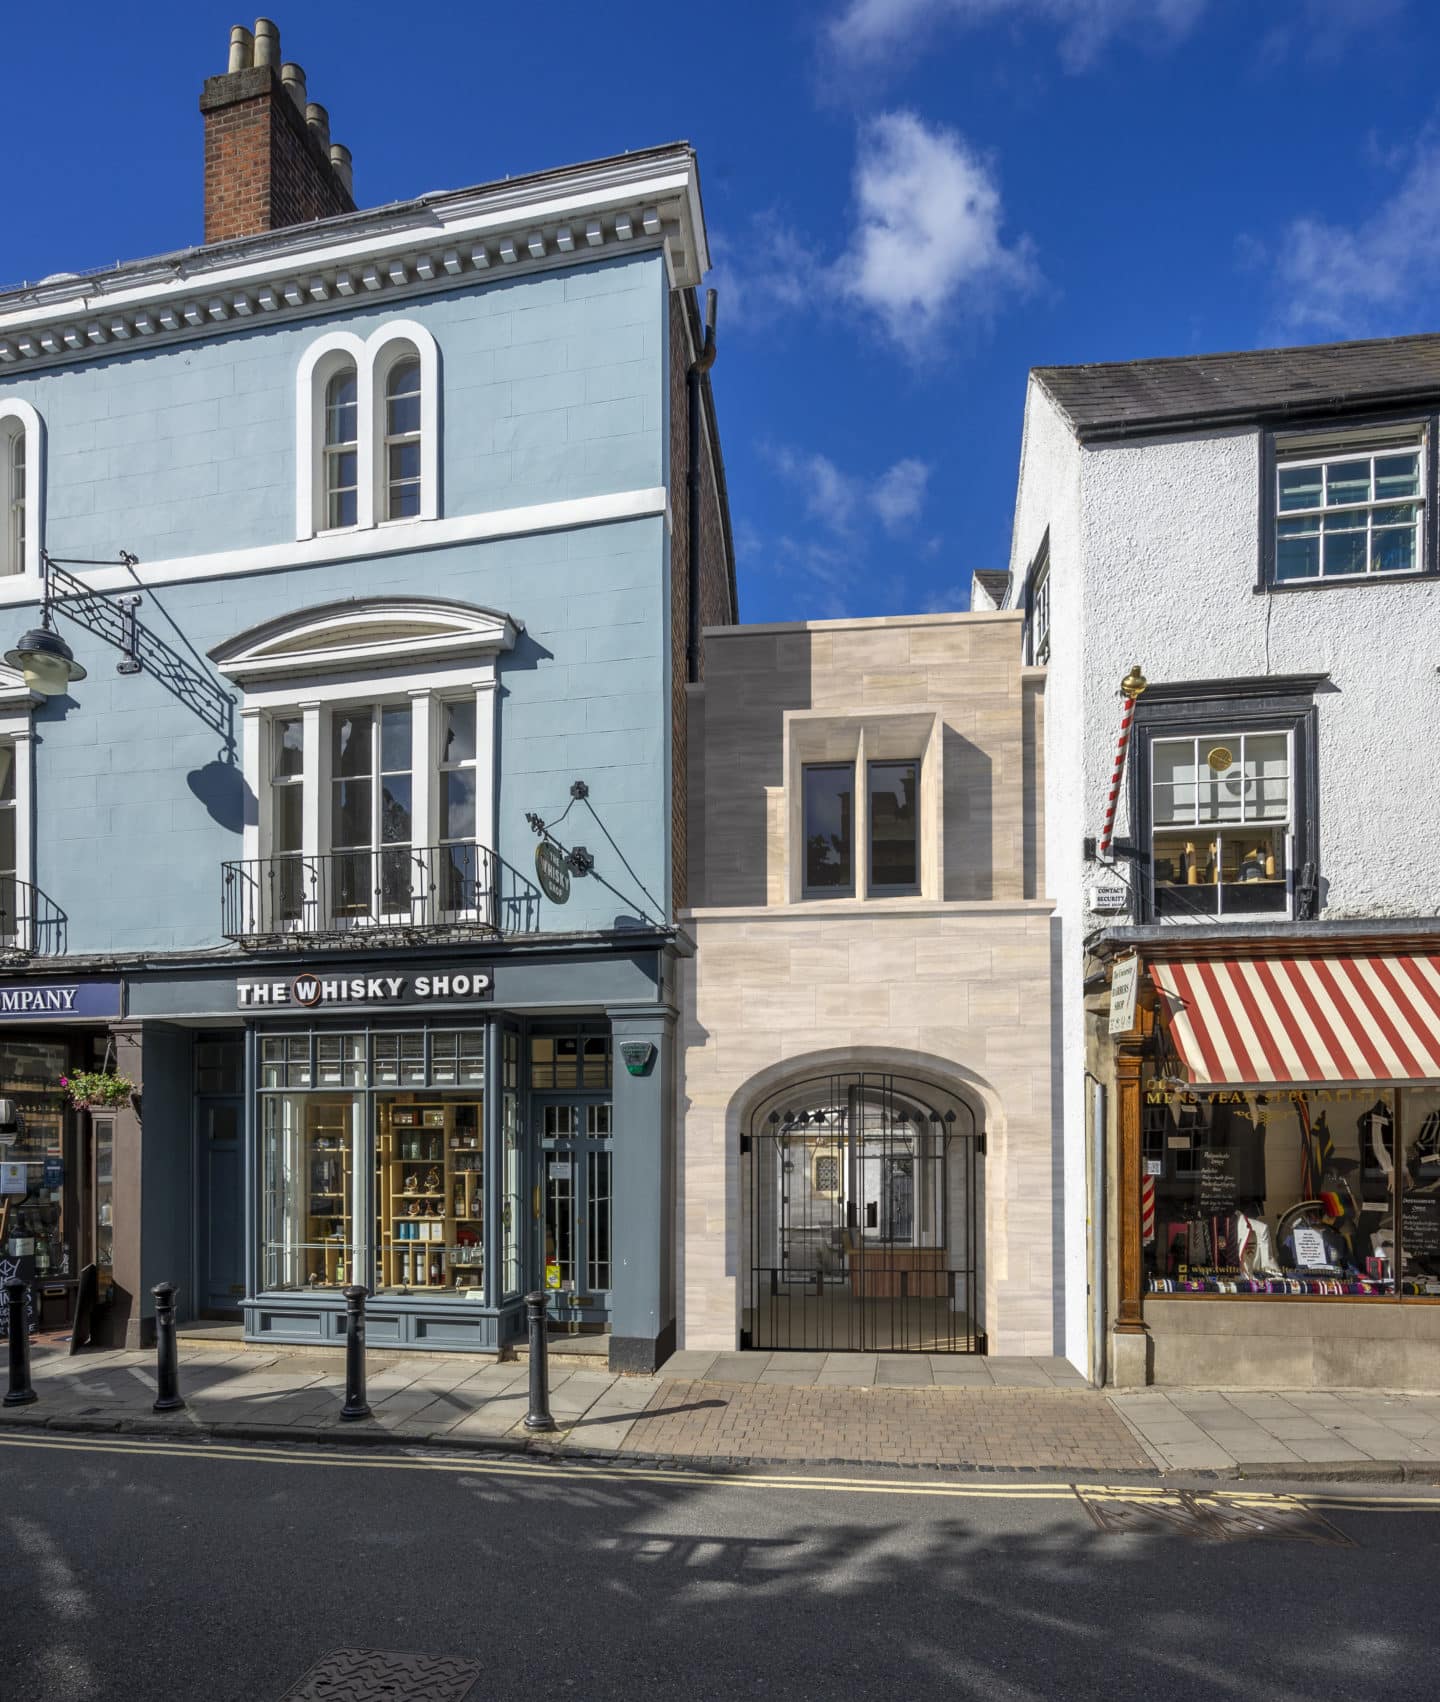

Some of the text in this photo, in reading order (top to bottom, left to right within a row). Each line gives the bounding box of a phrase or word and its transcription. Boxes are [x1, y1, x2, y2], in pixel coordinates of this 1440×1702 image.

[549, 851, 560, 867] THE
[540, 855, 569, 891] WHISKY
[237, 975, 489, 1002] THE WHISKY SHOP
